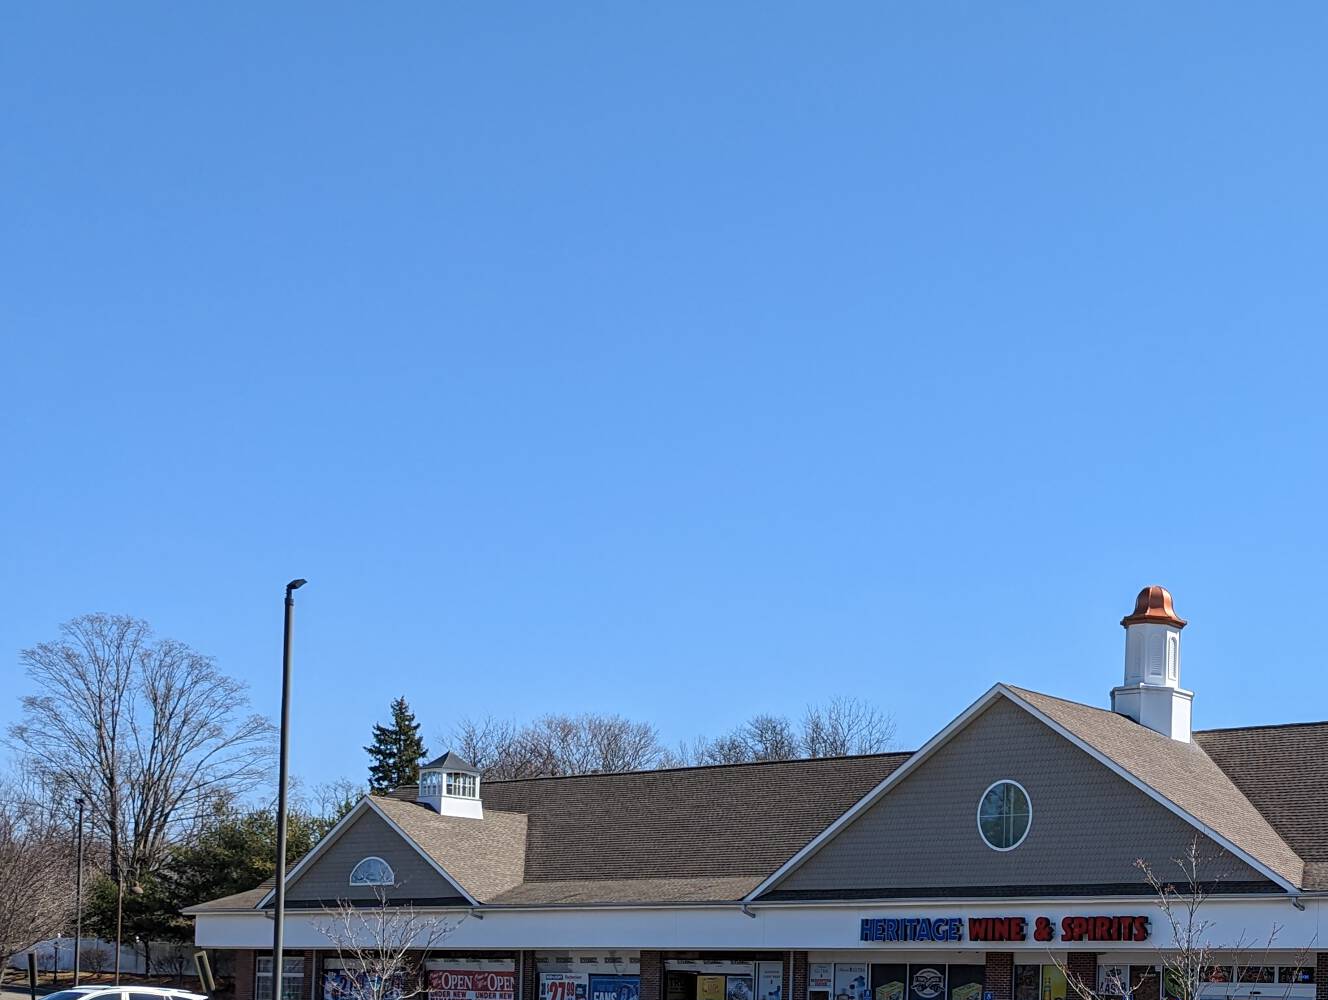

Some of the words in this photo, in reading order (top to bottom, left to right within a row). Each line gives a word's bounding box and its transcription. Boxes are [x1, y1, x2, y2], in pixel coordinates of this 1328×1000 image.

[860, 918, 963, 942] HERITAGE
[968, 917, 1028, 942] WINE
[1033, 916, 1055, 942] &
[1061, 916, 1150, 942] SPIRITS
[441, 972, 473, 990] OPEN
